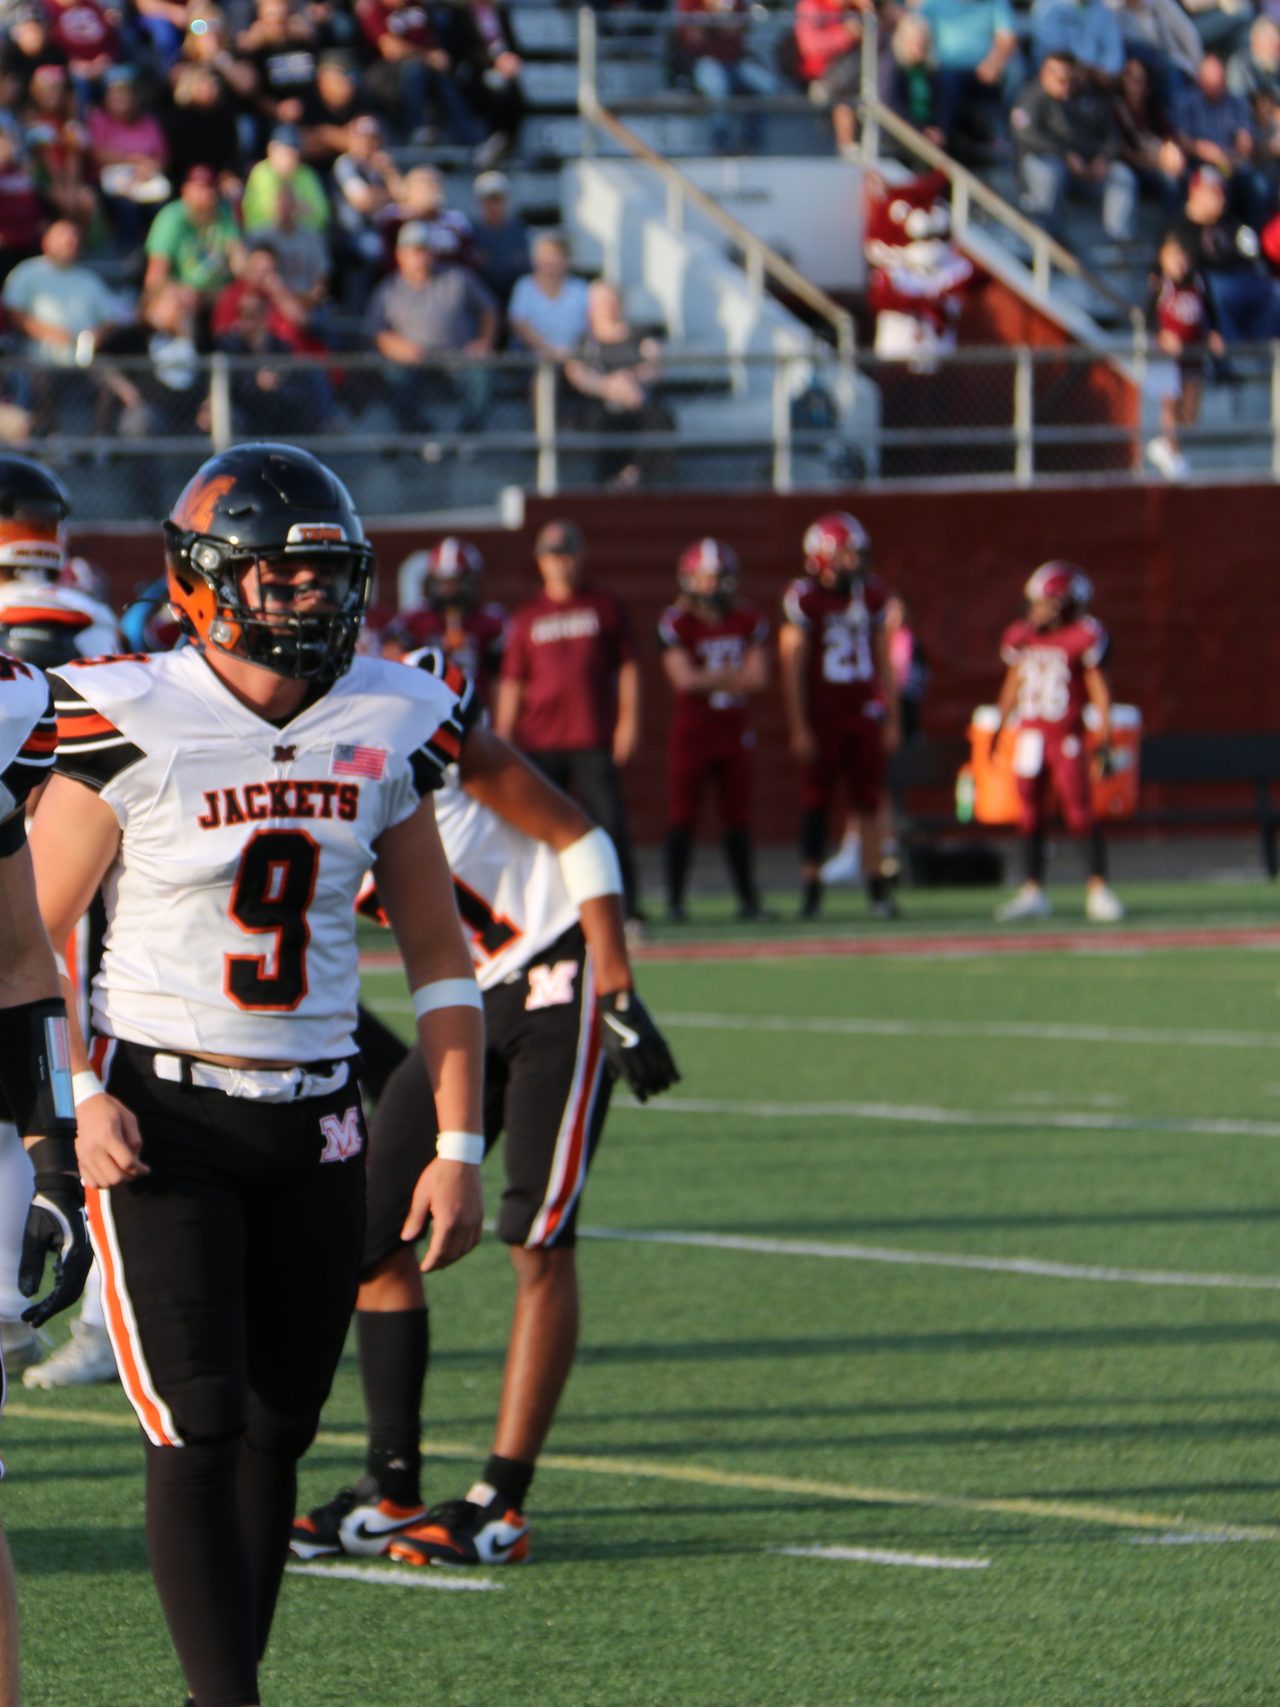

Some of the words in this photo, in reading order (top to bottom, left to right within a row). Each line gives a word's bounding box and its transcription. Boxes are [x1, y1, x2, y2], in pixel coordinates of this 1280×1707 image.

[823, 624, 873, 683] 21
[198, 780, 359, 830] JACKETS
[223, 828, 320, 1012] 9
[525, 960, 579, 1011] M
[319, 1106, 362, 1163] M
